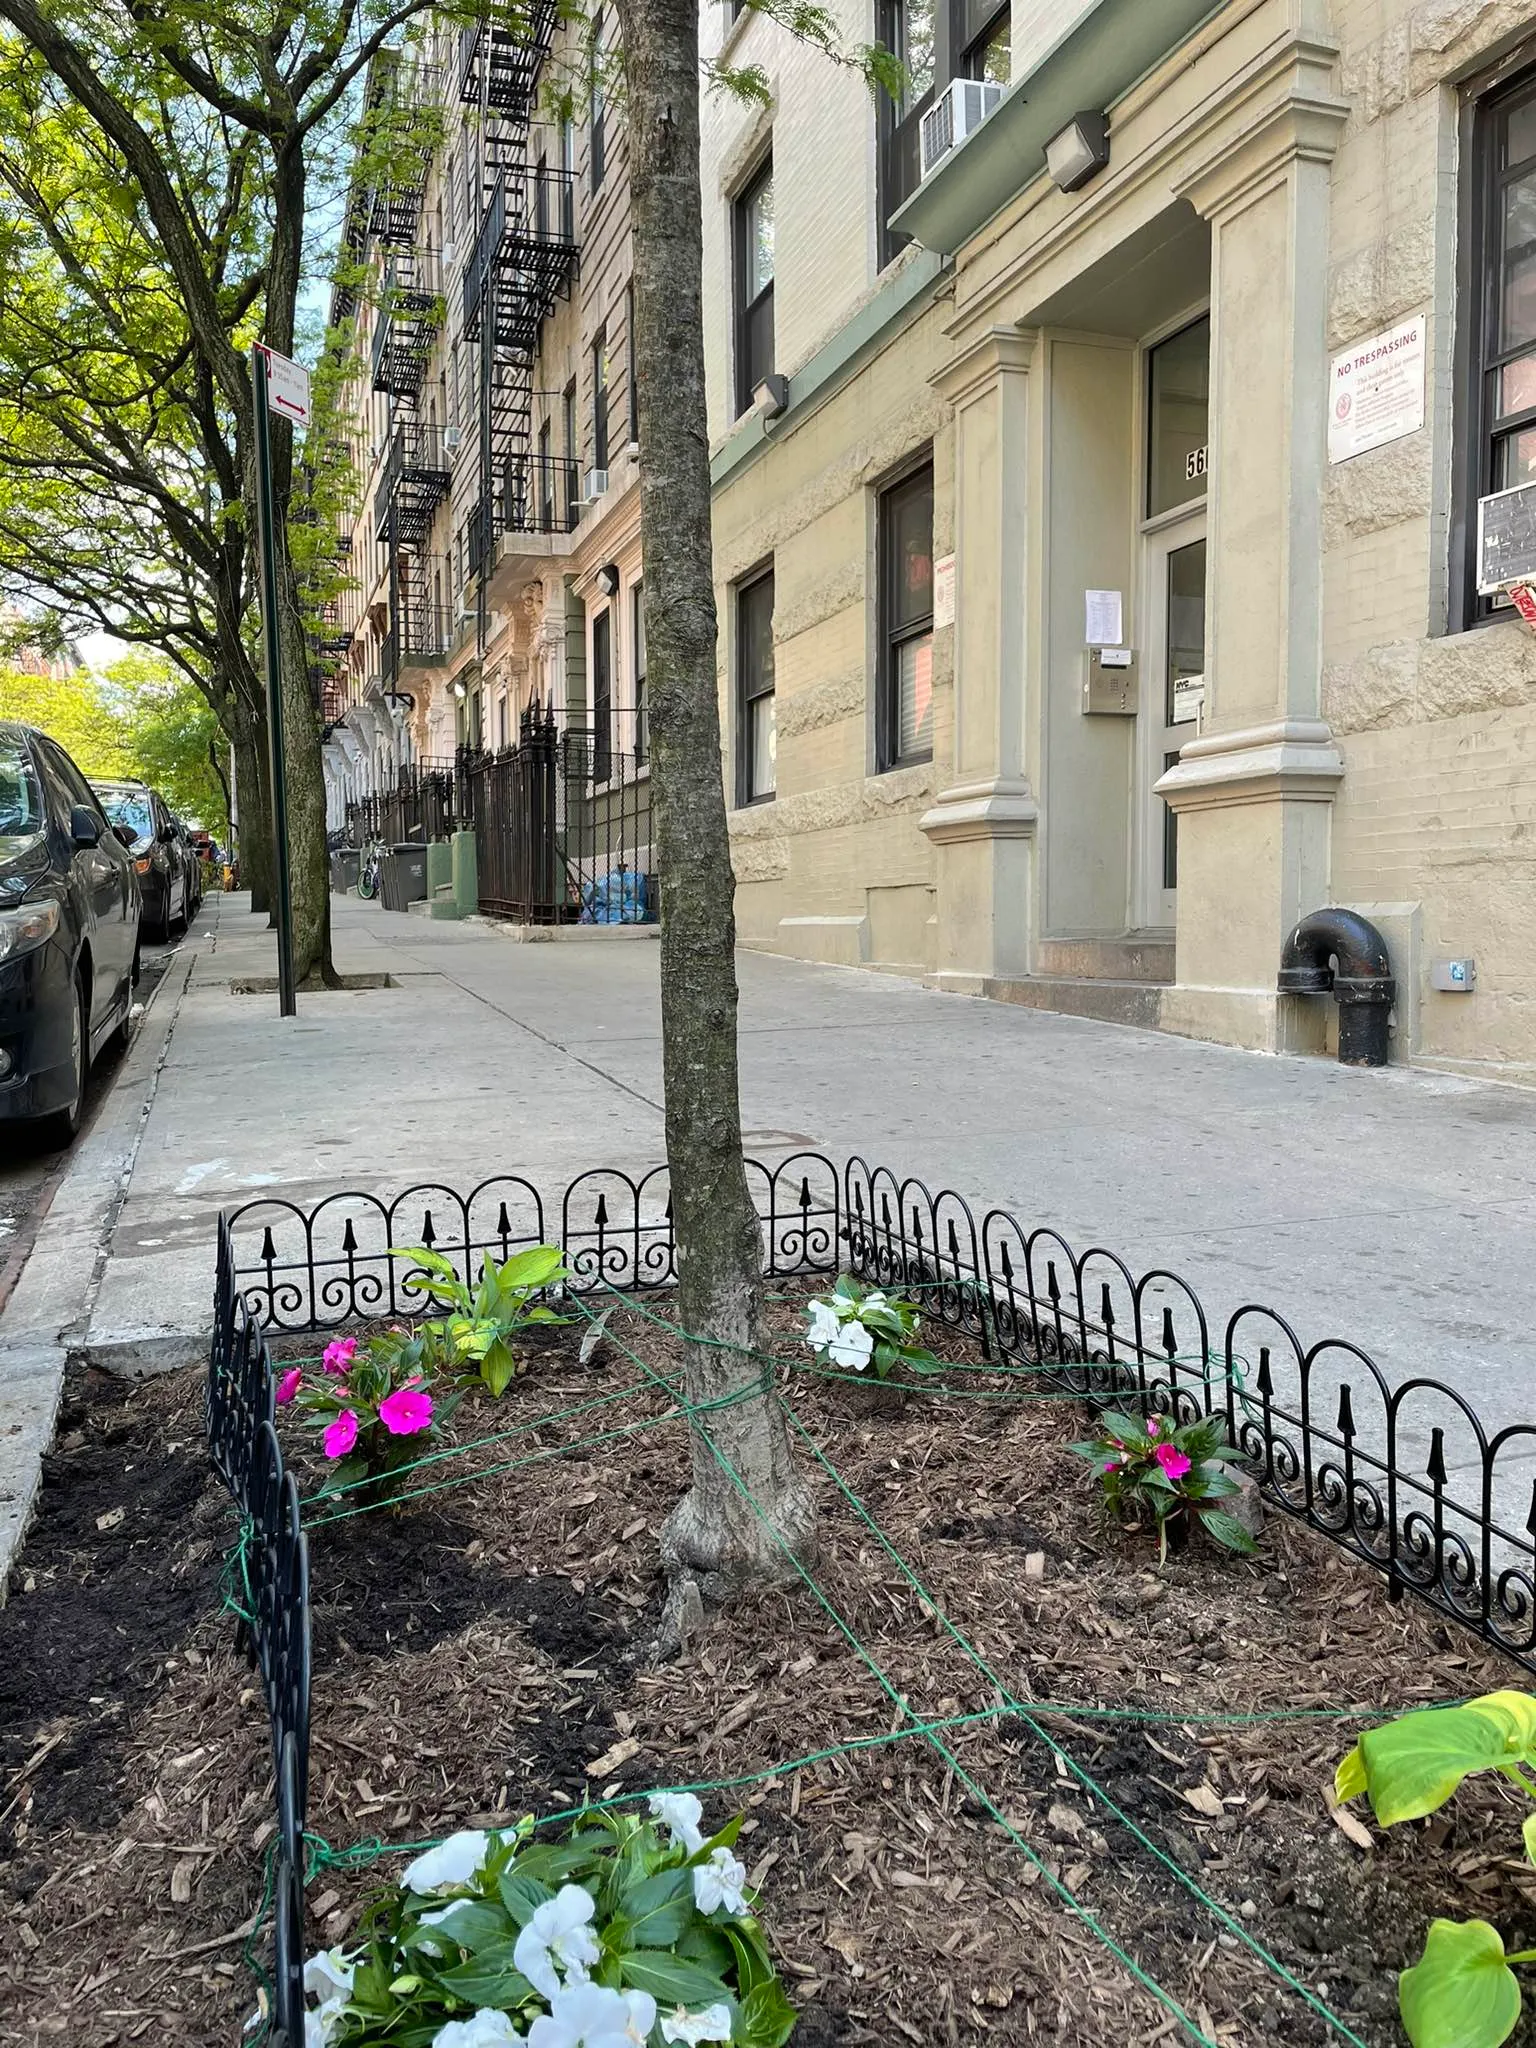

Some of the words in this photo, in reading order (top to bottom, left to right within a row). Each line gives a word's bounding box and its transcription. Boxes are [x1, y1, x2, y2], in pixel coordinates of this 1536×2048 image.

[1337, 363, 1351, 378] NO
[1354, 330, 1417, 369] TRESPASSING
[1188, 446, 1208, 478] 56
